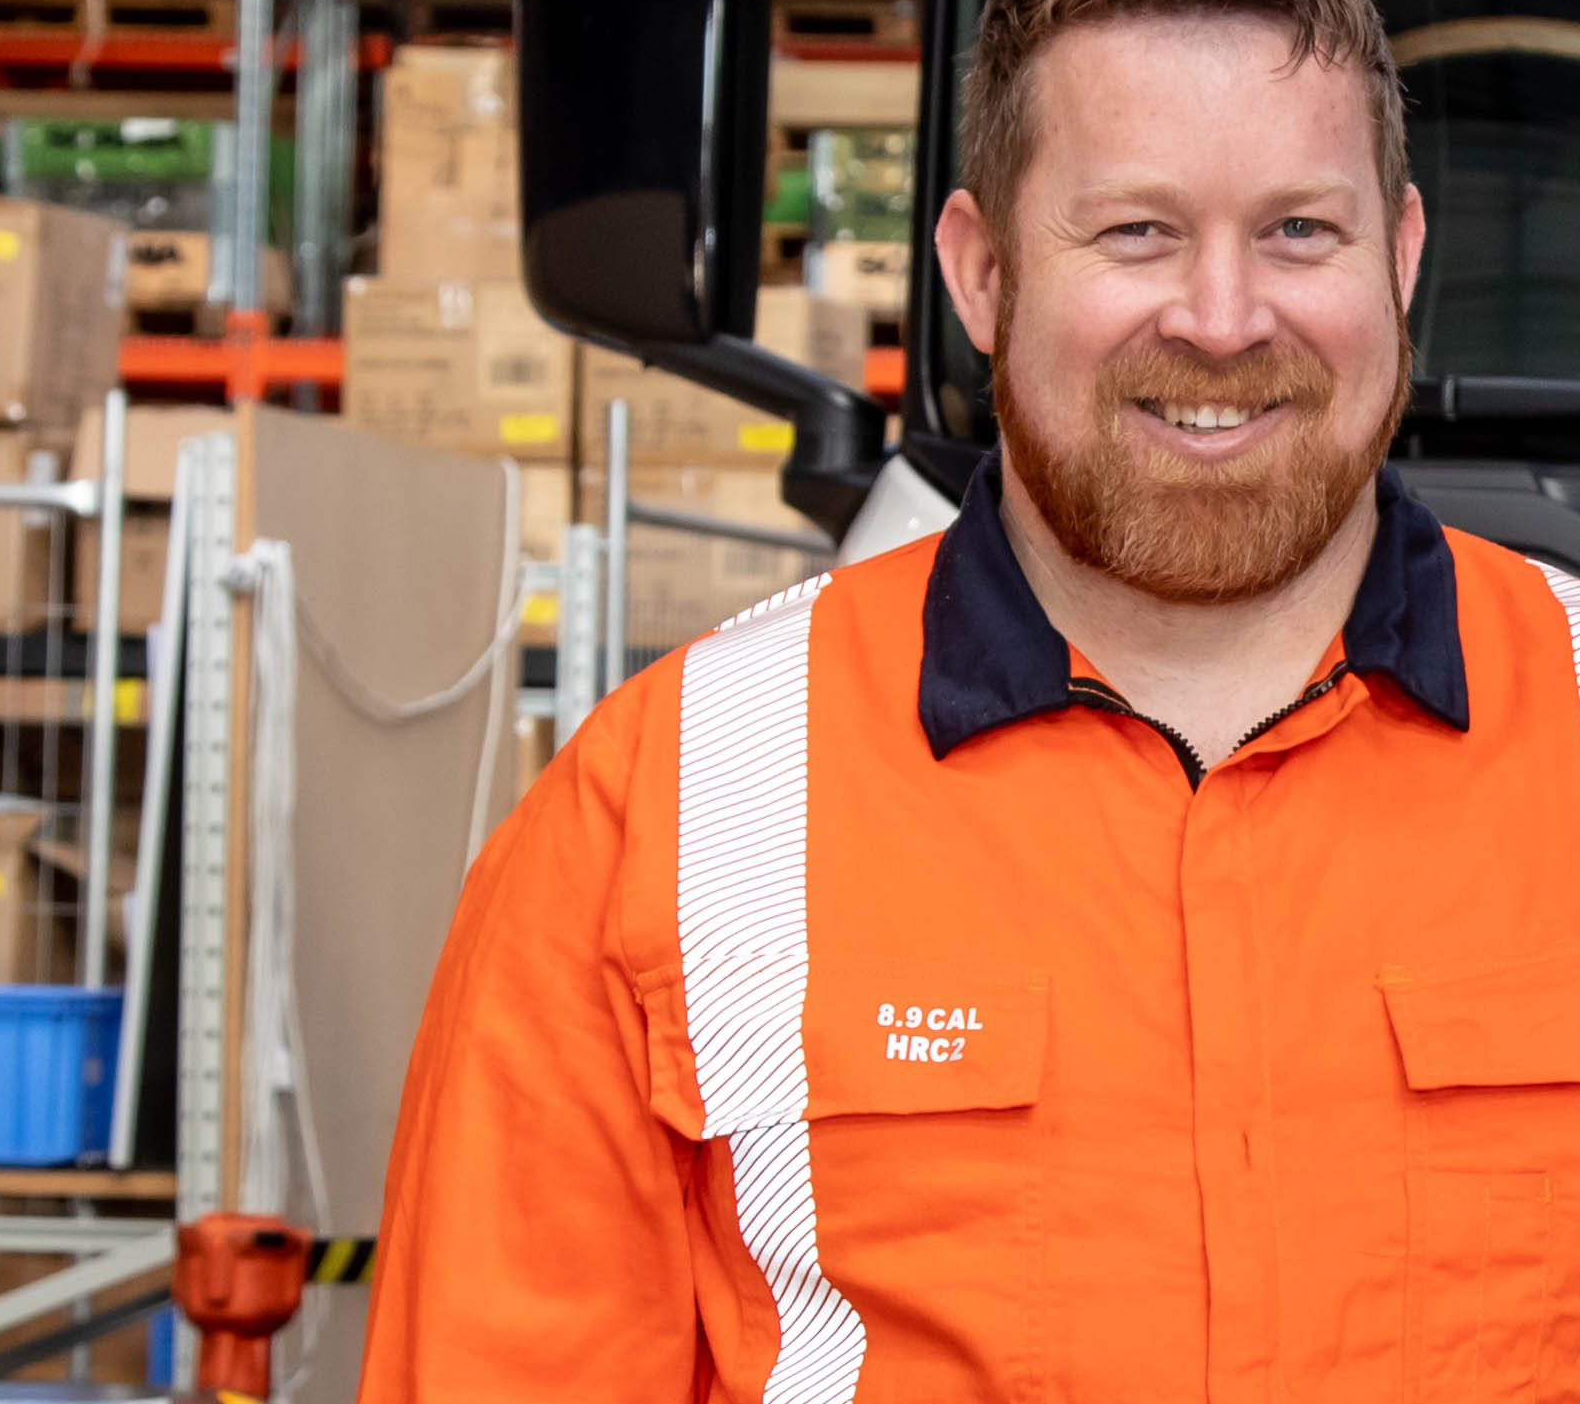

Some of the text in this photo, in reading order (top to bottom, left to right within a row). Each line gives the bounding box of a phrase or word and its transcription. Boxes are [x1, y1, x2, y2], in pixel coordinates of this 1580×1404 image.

[876, 1003, 984, 1031] 8.9 CAL
[885, 1033, 967, 1063] HRC2
